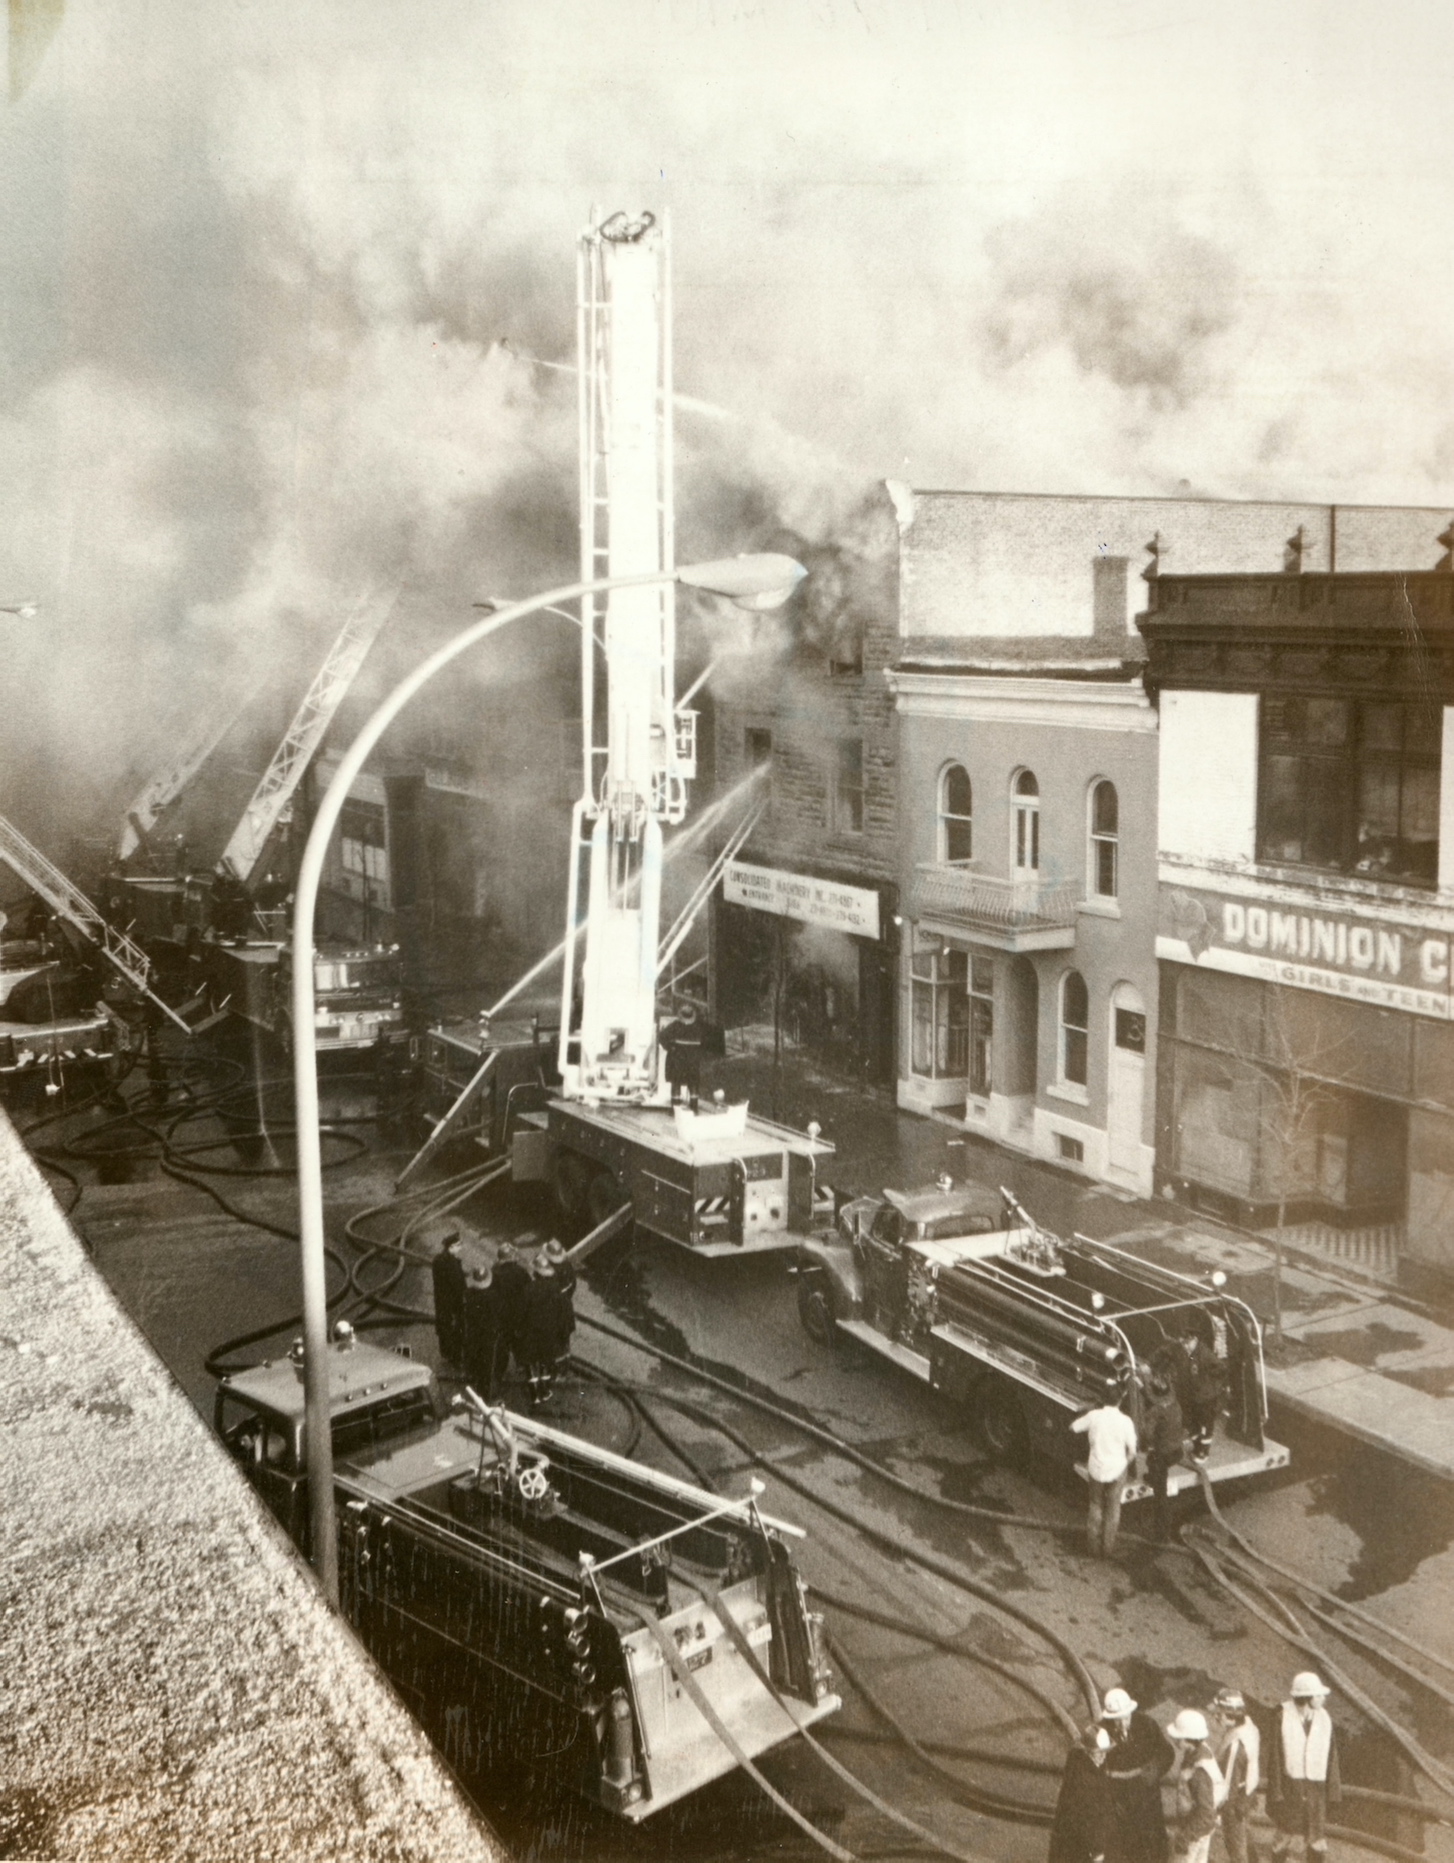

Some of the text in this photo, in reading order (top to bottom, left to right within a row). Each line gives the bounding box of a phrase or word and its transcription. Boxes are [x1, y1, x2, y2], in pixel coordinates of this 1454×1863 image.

[1223, 902, 1401, 976] DOMINION
[1281, 966, 1351, 993] GIRLS
[1382, 986, 1447, 1013] TEEN
